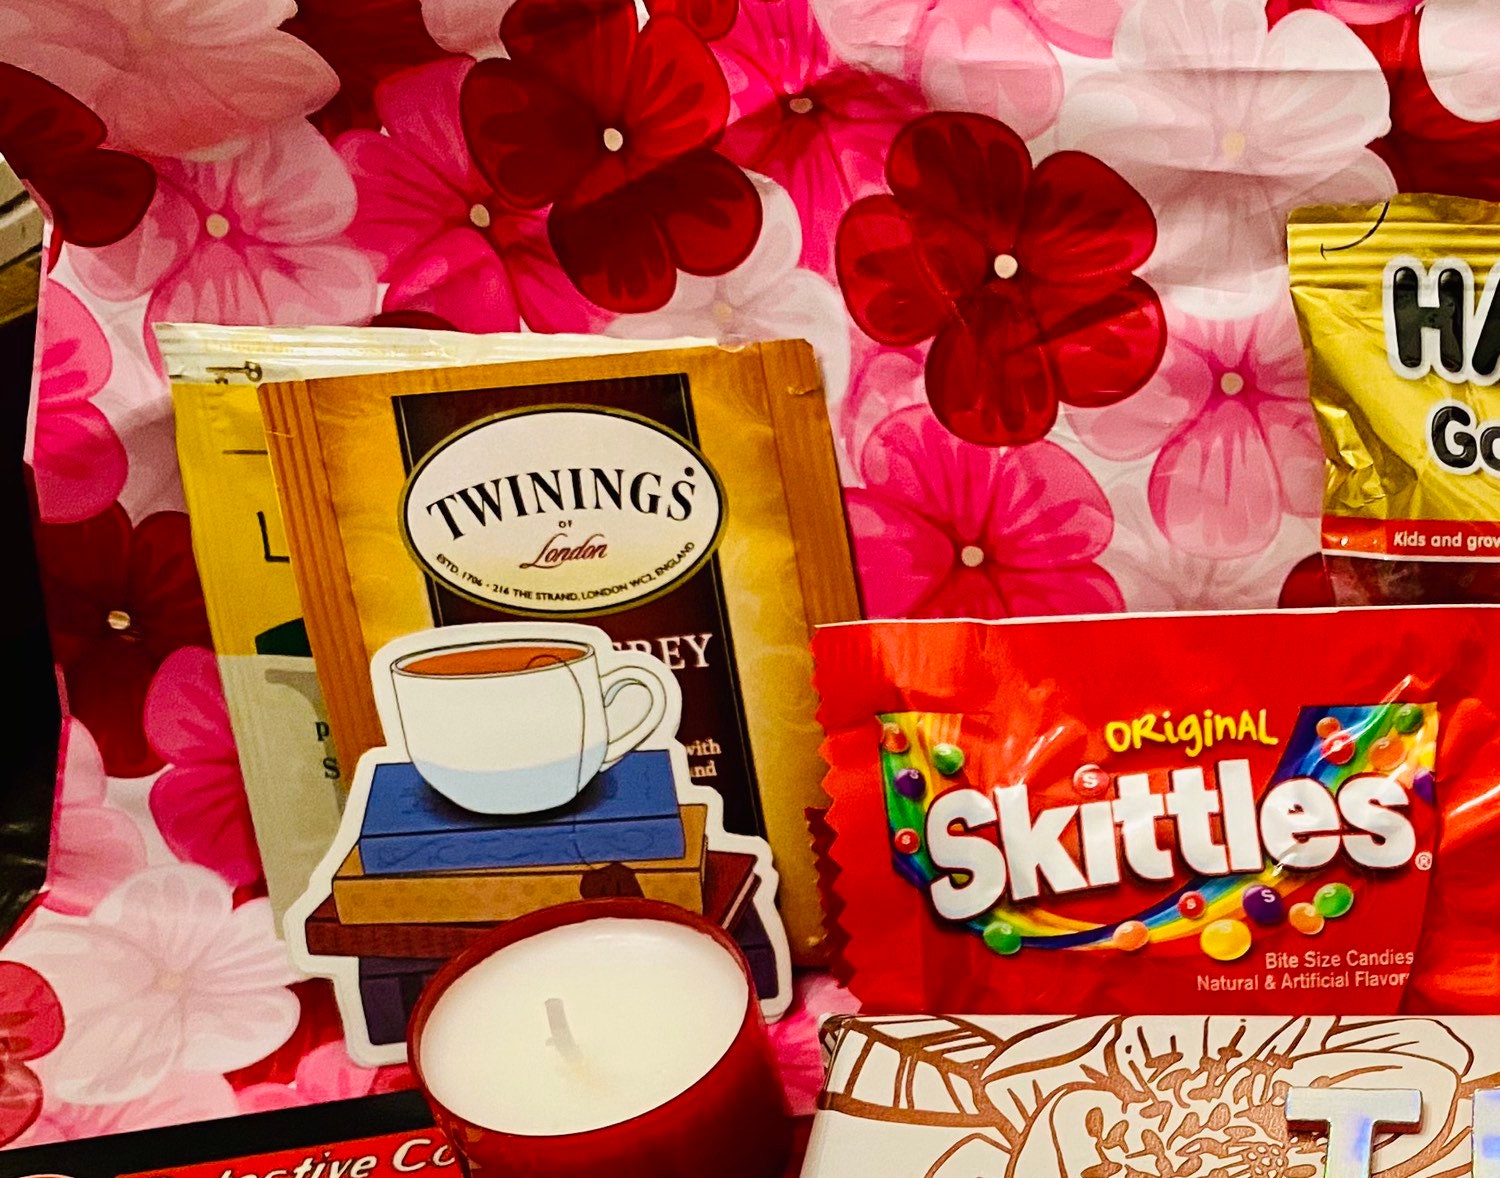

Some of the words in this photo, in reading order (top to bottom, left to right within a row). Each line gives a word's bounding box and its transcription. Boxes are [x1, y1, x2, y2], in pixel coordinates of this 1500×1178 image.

[426, 466, 696, 541] TWININGS
[558, 520, 573, 529] OF
[519, 533, 608, 569] London
[1394, 531, 1426, 547] Kids
[1431, 532, 1462, 547] and
[462, 573, 483, 587] 1706
[513, 588, 533, 599] THE
[582, 583, 628, 600] LONDON
[655, 541, 695, 576] ENGLAND
[926, 758, 1417, 921] Skittles
[1265, 952, 1299, 970] Bite
[1304, 950, 1341, 968] Size
[1346, 949, 1415, 967] Candies
[1197, 974, 1259, 991] Natural
[1264, 974, 1277, 990] &
[1281, 971, 1350, 990] Artificial
[1355, 970, 1411, 988] Flavor
